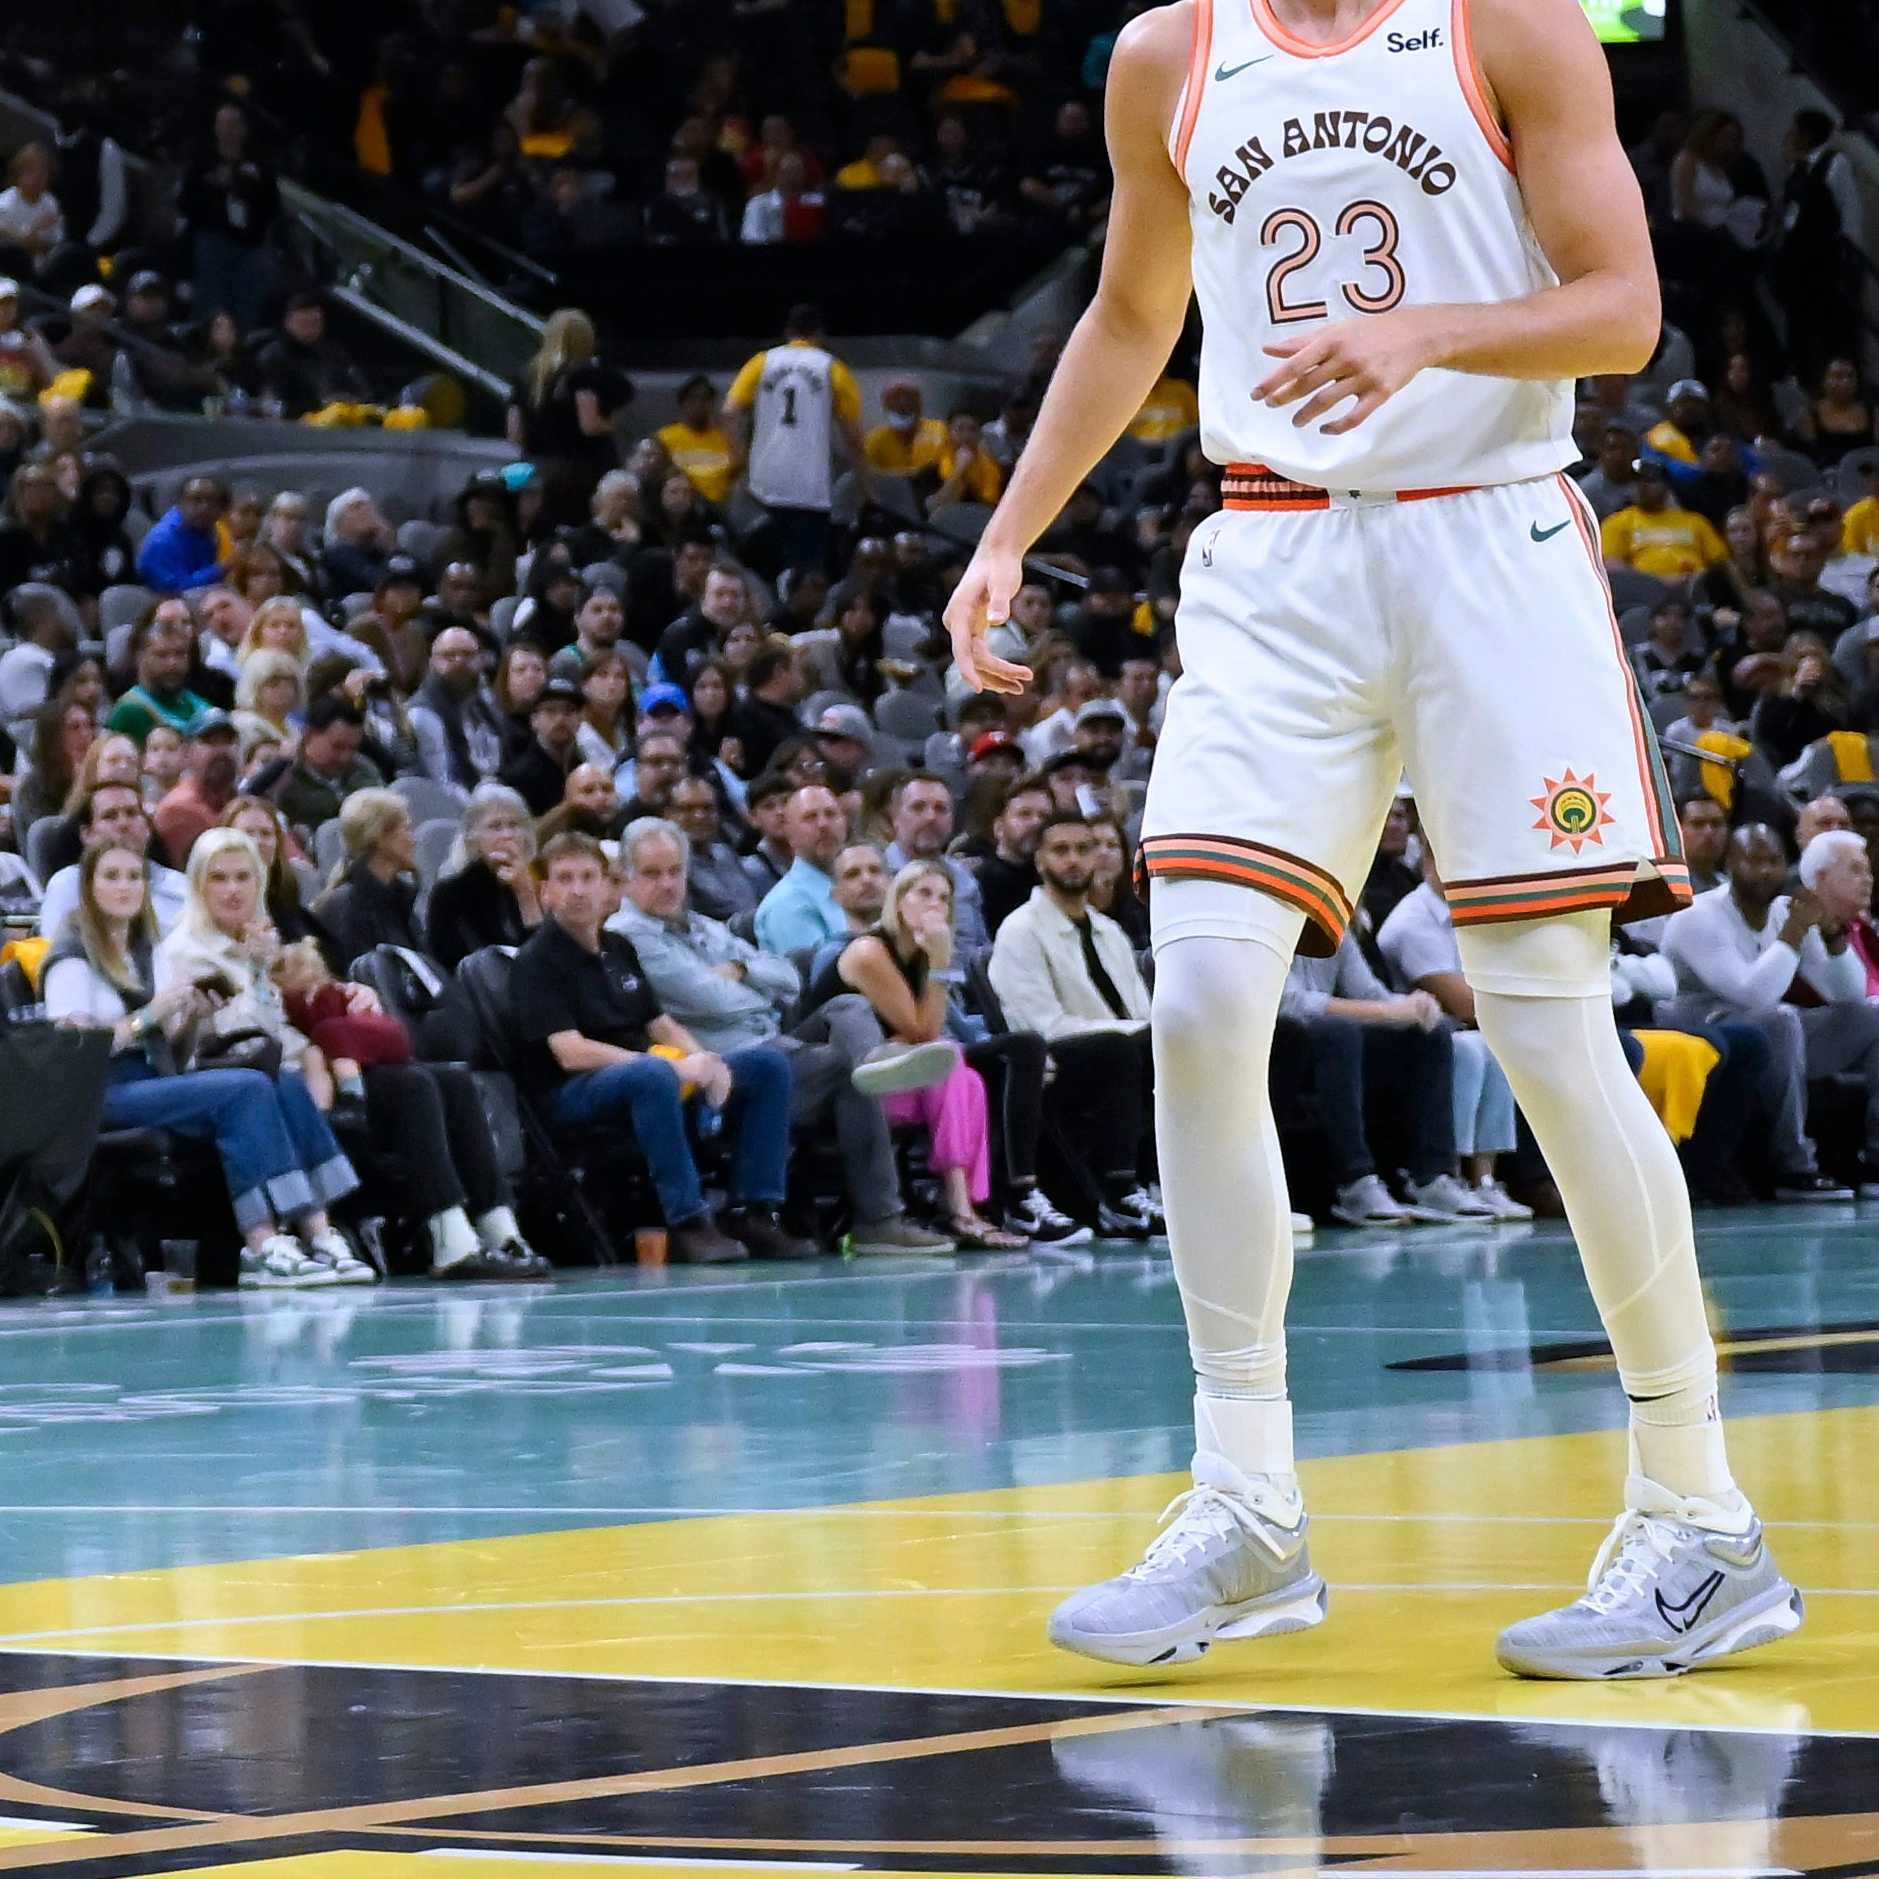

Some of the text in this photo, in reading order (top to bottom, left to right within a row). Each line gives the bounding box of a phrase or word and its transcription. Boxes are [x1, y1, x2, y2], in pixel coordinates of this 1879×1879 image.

[1208, 110, 1457, 225] SAN ANTONIO
[1260, 199, 1406, 325] 23
